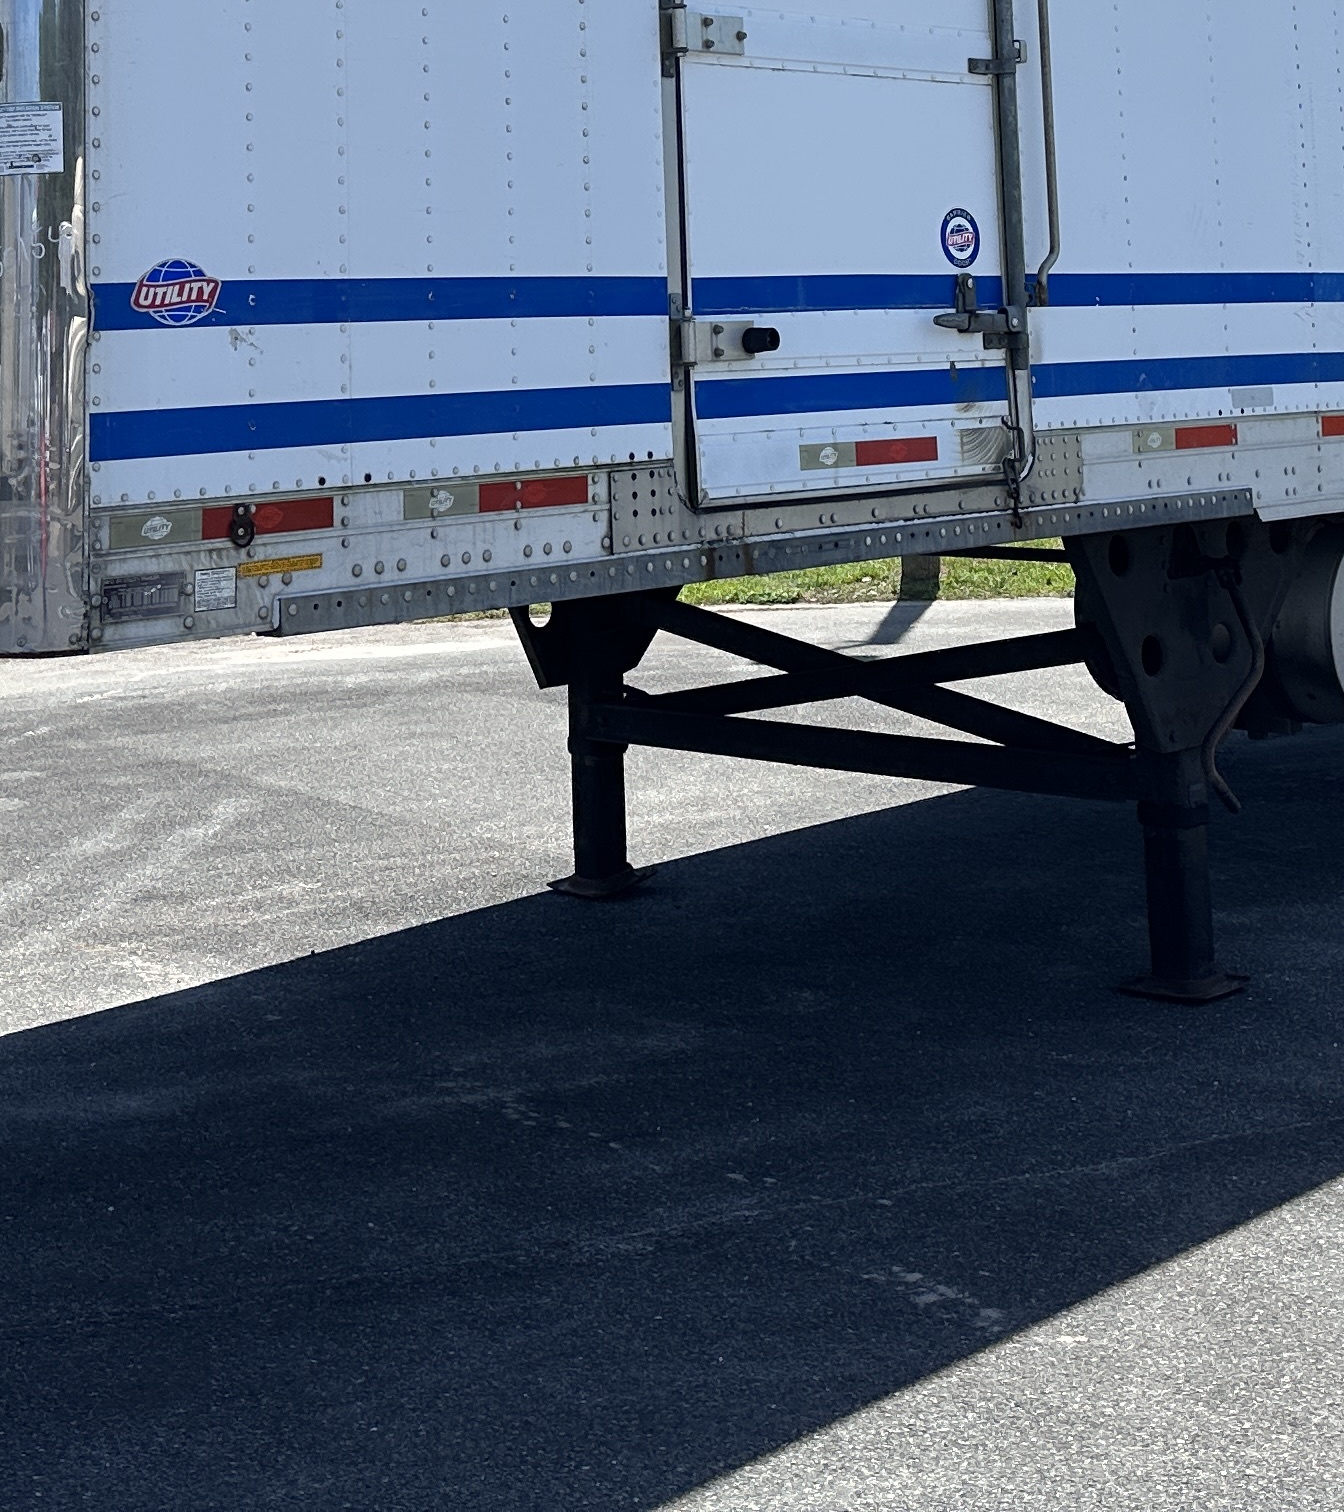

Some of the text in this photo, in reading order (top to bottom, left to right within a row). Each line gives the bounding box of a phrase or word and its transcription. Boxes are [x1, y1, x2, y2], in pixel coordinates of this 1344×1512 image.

[948, 232, 975, 246] UTILITY
[138, 281, 216, 306] UTILITY
[142, 522, 173, 536] UTILITY
